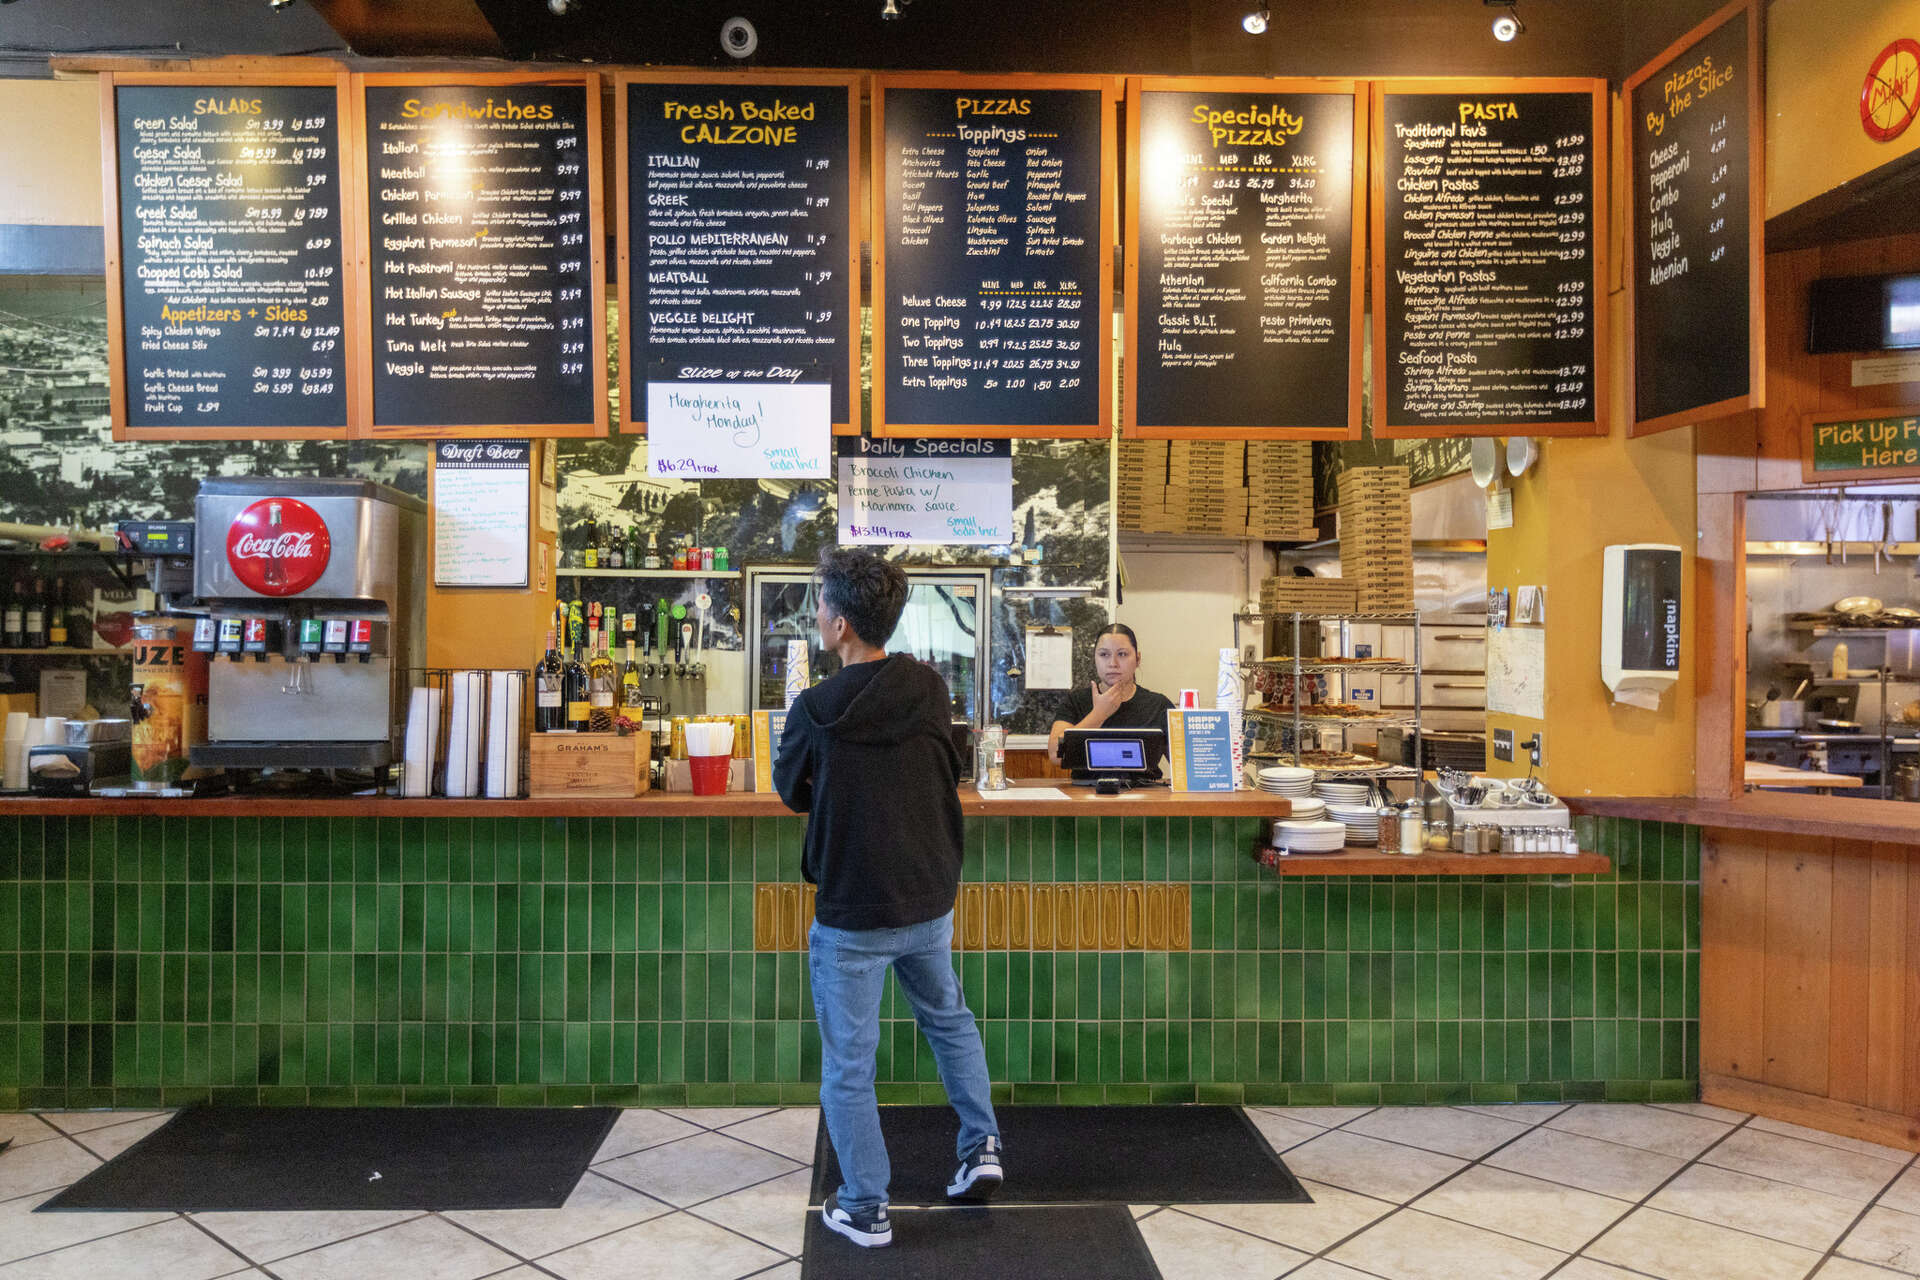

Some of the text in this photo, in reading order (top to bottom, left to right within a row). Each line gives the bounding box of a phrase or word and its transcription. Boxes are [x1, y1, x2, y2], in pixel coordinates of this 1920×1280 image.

[1665, 56, 1711, 104] Pizzas
[193, 99, 262, 115] SALADS
[957, 97, 1031, 118] PIZZAS
[1646, 65, 1734, 136] By the Slice
[401, 99, 553, 120] Sandwiches
[664, 100, 814, 121] Fresh Baked
[1459, 103, 1518, 123] PASTA
[134, 116, 198, 130] Green Salad
[1192, 105, 1303, 135] Specialty
[681, 123, 797, 146] CALZONE
[957, 126, 1026, 143] Toppings
[1395, 122, 1487, 138] Traditional Fav's
[1213, 128, 1286, 148] PIZZAS
[1404, 135, 1584, 149] Spaghetti 11.99
[134, 145, 201, 158] Caesar Salad
[383, 143, 418, 154] Italian
[648, 156, 699, 168] ITALIAN
[1220, 154, 1316, 167] MED LRG XLRG
[1404, 155, 1443, 165] Lasagna
[1650, 142, 1678, 170] Cheese
[381, 168, 425, 179] Meatball
[1404, 166, 1441, 176] Ravioli
[1650, 151, 1690, 193] Pepperoni
[135, 173, 242, 187] Chicken Caesar Salad
[1247, 179, 1274, 189] 26.75
[1397, 178, 1479, 191] Chicken Pastas
[381, 190, 419, 200] Chicken
[649, 195, 688, 206] GREEK
[1201, 193, 1233, 206] Special
[1260, 193, 1312, 205] Margherita
[1404, 193, 1464, 203] Chicken Alfredo
[1650, 188, 1679, 214] Combo
[136, 204, 197, 219] Greek Salad
[383, 213, 462, 225] Grilled Chicken
[1651, 218, 1672, 238] Hula
[137, 236, 331, 252] Spinach Salad 6.99
[384, 237, 477, 252] Eggplant Parmesan
[649, 234, 788, 246] POLLO MEDITERRANEAN
[1161, 234, 1241, 248] Barbeque Chicken
[1261, 234, 1326, 246] Garden Delight
[1650, 232, 1680, 261] Veggie
[137, 267, 180, 282] Chopped
[184, 266, 210, 278] Cobb
[214, 266, 242, 278] Salad
[305, 268, 333, 278] 10.49
[385, 261, 453, 274] Hot Pastrami
[1650, 256, 1688, 286] Athenian
[649, 272, 709, 284] MEATBALL
[1160, 274, 1204, 286] Athenian
[1261, 274, 1336, 287] California Combo
[1397, 270, 1496, 284] Vegetarian Pastas
[385, 288, 480, 300] Hot Italian Sausage
[903, 295, 1081, 309] Deluxe Cheese 28.50
[161, 305, 307, 328] Appetizers Sides
[386, 313, 444, 330] Hot Turkey
[650, 312, 755, 324] VEGGIE DELIGHT
[902, 316, 960, 331] One Topping
[1159, 315, 1189, 326] Classic
[1260, 315, 1331, 327] Pesto Primivera
[141, 326, 221, 339] Spicy Chicken Wings
[142, 342, 159, 350] Fried
[163, 342, 189, 350] Cheese
[387, 340, 446, 352] Tuna Melt
[903, 336, 963, 349] Two Toppings
[1159, 339, 1181, 351] Hula
[903, 356, 1053, 370] Three Toppings 26.75
[1399, 350, 1477, 366] Seafood Pasta
[387, 363, 424, 376] Veggie
[678, 367, 721, 379] Slice
[727, 370, 739, 379] of
[767, 367, 803, 384] Day
[1404, 367, 1466, 377] Shrimp Alfredo
[144, 383, 218, 393] Garlic Cheese Bread
[903, 376, 1079, 390] Extra Toppings 2.00
[145, 403, 183, 414] Fruit Cup
[669, 393, 740, 422] Margherita
[1819, 425, 1863, 446] Pick
[1870, 422, 1897, 447] Up
[442, 444, 523, 461] Draft Beer
[860, 438, 994, 457] Daily Specials
[1862, 448, 1917, 466] Here
[850, 465, 954, 480] Broccoli Chicken
[848, 485, 940, 500] Penne Pasta w/
[861, 502, 915, 512] Marinara
[233, 532, 314, 559] Coca-Cola
[1664, 605, 1679, 666] napkins
[558, 744, 609, 752] GRAHAM'S
